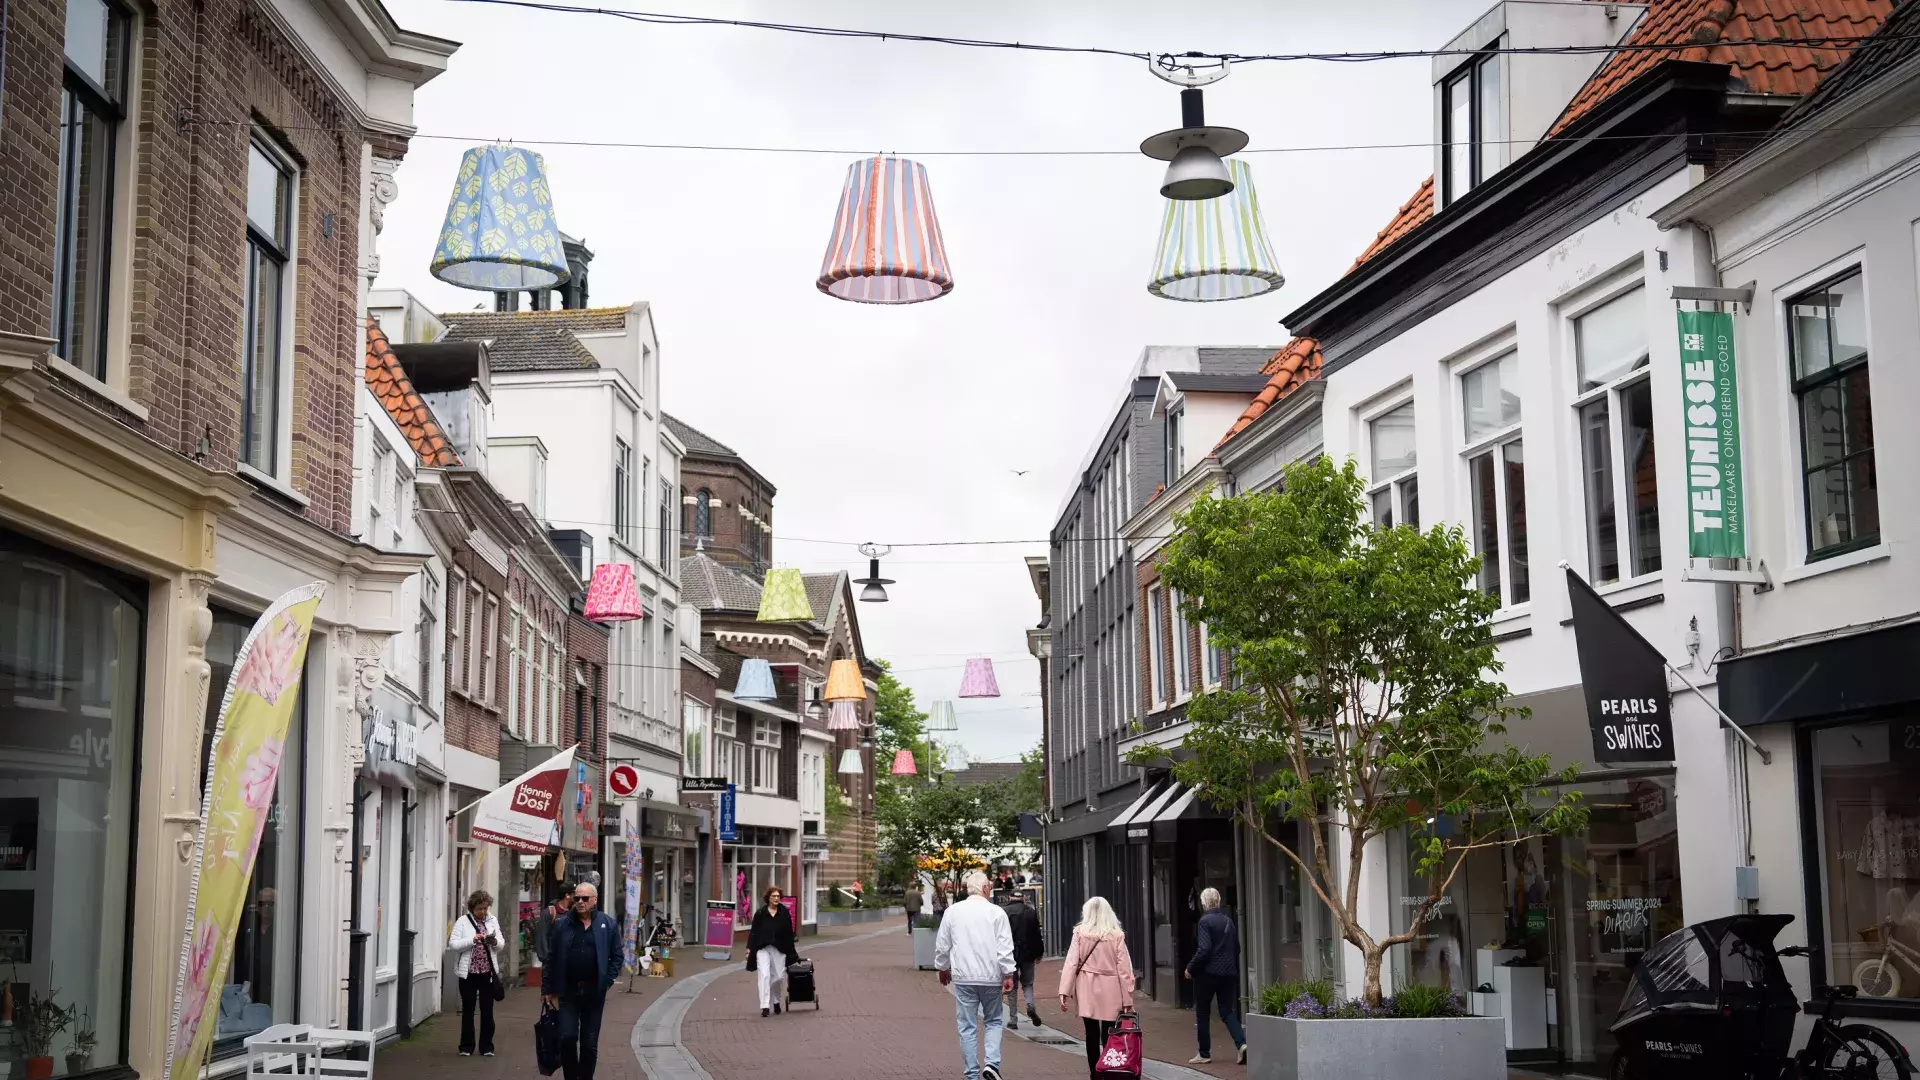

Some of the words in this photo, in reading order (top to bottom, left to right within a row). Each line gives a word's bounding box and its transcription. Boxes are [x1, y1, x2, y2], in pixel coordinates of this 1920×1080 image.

[1717, 335, 1730, 373] GOED
[1720, 377, 1735, 458] ONROEREND
[1684, 359, 1723, 533] TEUNISSE
[1725, 462, 1739, 534] MAKELAARS
[1600, 698, 1658, 715] PEARLS
[1625, 714, 1639, 722] and
[1603, 723, 1662, 750] SWINES
[516, 792, 551, 812] Dost
[520, 783, 552, 799] Hennie
[473, 829, 546, 853] voordeelgordijnen.nl
[1586, 899, 1644, 911] SPRING-SUMMER
[1644, 898, 1662, 908] 2024
[1604, 907, 1648, 935] DIARIES
[1646, 1040, 1672, 1052] PEARLS
[1680, 1042, 1704, 1054] SWINES
